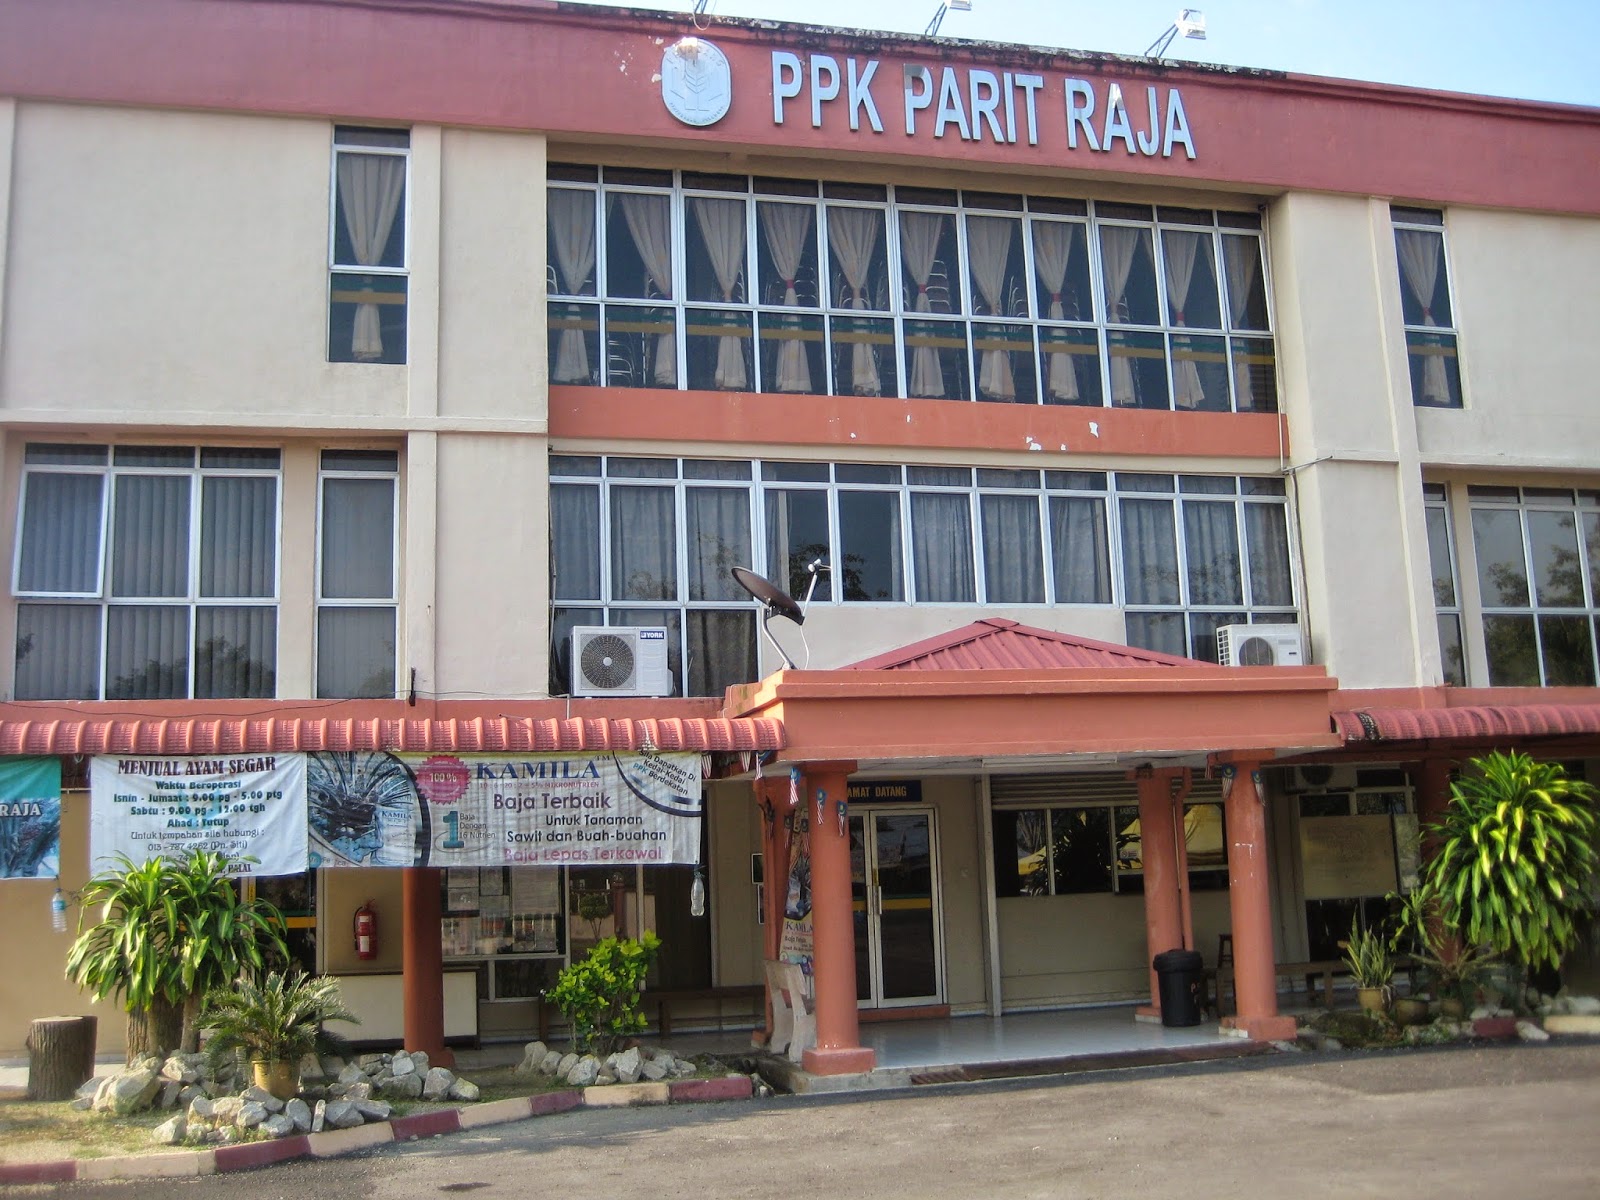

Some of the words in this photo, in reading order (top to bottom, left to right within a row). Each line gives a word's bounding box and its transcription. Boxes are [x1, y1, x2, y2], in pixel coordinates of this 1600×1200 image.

[771, 51, 884, 133] PPK
[904, 63, 1044, 146] PARIT
[1065, 79, 1197, 160] RAJA
[118, 759, 180, 777] MENJUAL
[185, 759, 224, 776] AYAM
[230, 756, 276, 774] SEGAR
[476, 760, 601, 779] KAMILA
[639, 750, 652, 760] Sila
[654, 755, 687, 776] Dapatkan
[688, 773, 697, 782] Di
[643, 759, 686, 785] Kedai-Kedai
[429, 772, 445, 783] 100
[648, 770, 689, 795] Berdekatan
[155, 781, 186, 790] Waktu
[189, 780, 241, 791] Beroperasi
[847, 786, 870, 797] AMAT
[875, 786, 907, 797] DATANG
[113, 794, 137, 803] Isnin
[148, 794, 183, 803] Jumaat
[192, 793, 215, 802] 9.00
[241, 791, 263, 800] 5.00
[266, 790, 283, 800] ptg
[493, 793, 535, 814] Baja
[541, 792, 612, 810] Terbaik
[0, 803, 41, 817] RAJA
[131, 806, 158, 816] Sabtu
[168, 806, 191, 816] 9.00
[218, 804, 246, 814] 12.00
[249, 803, 265, 814] tgh
[382, 811, 412, 819] KAMILA
[167, 819, 193, 828] Ahad
[202, 818, 230, 829] Tutup
[546, 815, 580, 826] Untuk
[584, 814, 643, 826] Tanaman
[131, 831, 157, 840] Untuk
[160, 830, 202, 841] tempahan
[223, 828, 259, 839] hubungi
[507, 831, 542, 842] Sawit
[546, 830, 572, 842] dan
[577, 829, 667, 842] Buah-buahan
[504, 848, 539, 864] Baja
[543, 848, 588, 862] Lepas
[593, 846, 662, 861] Terkawal
